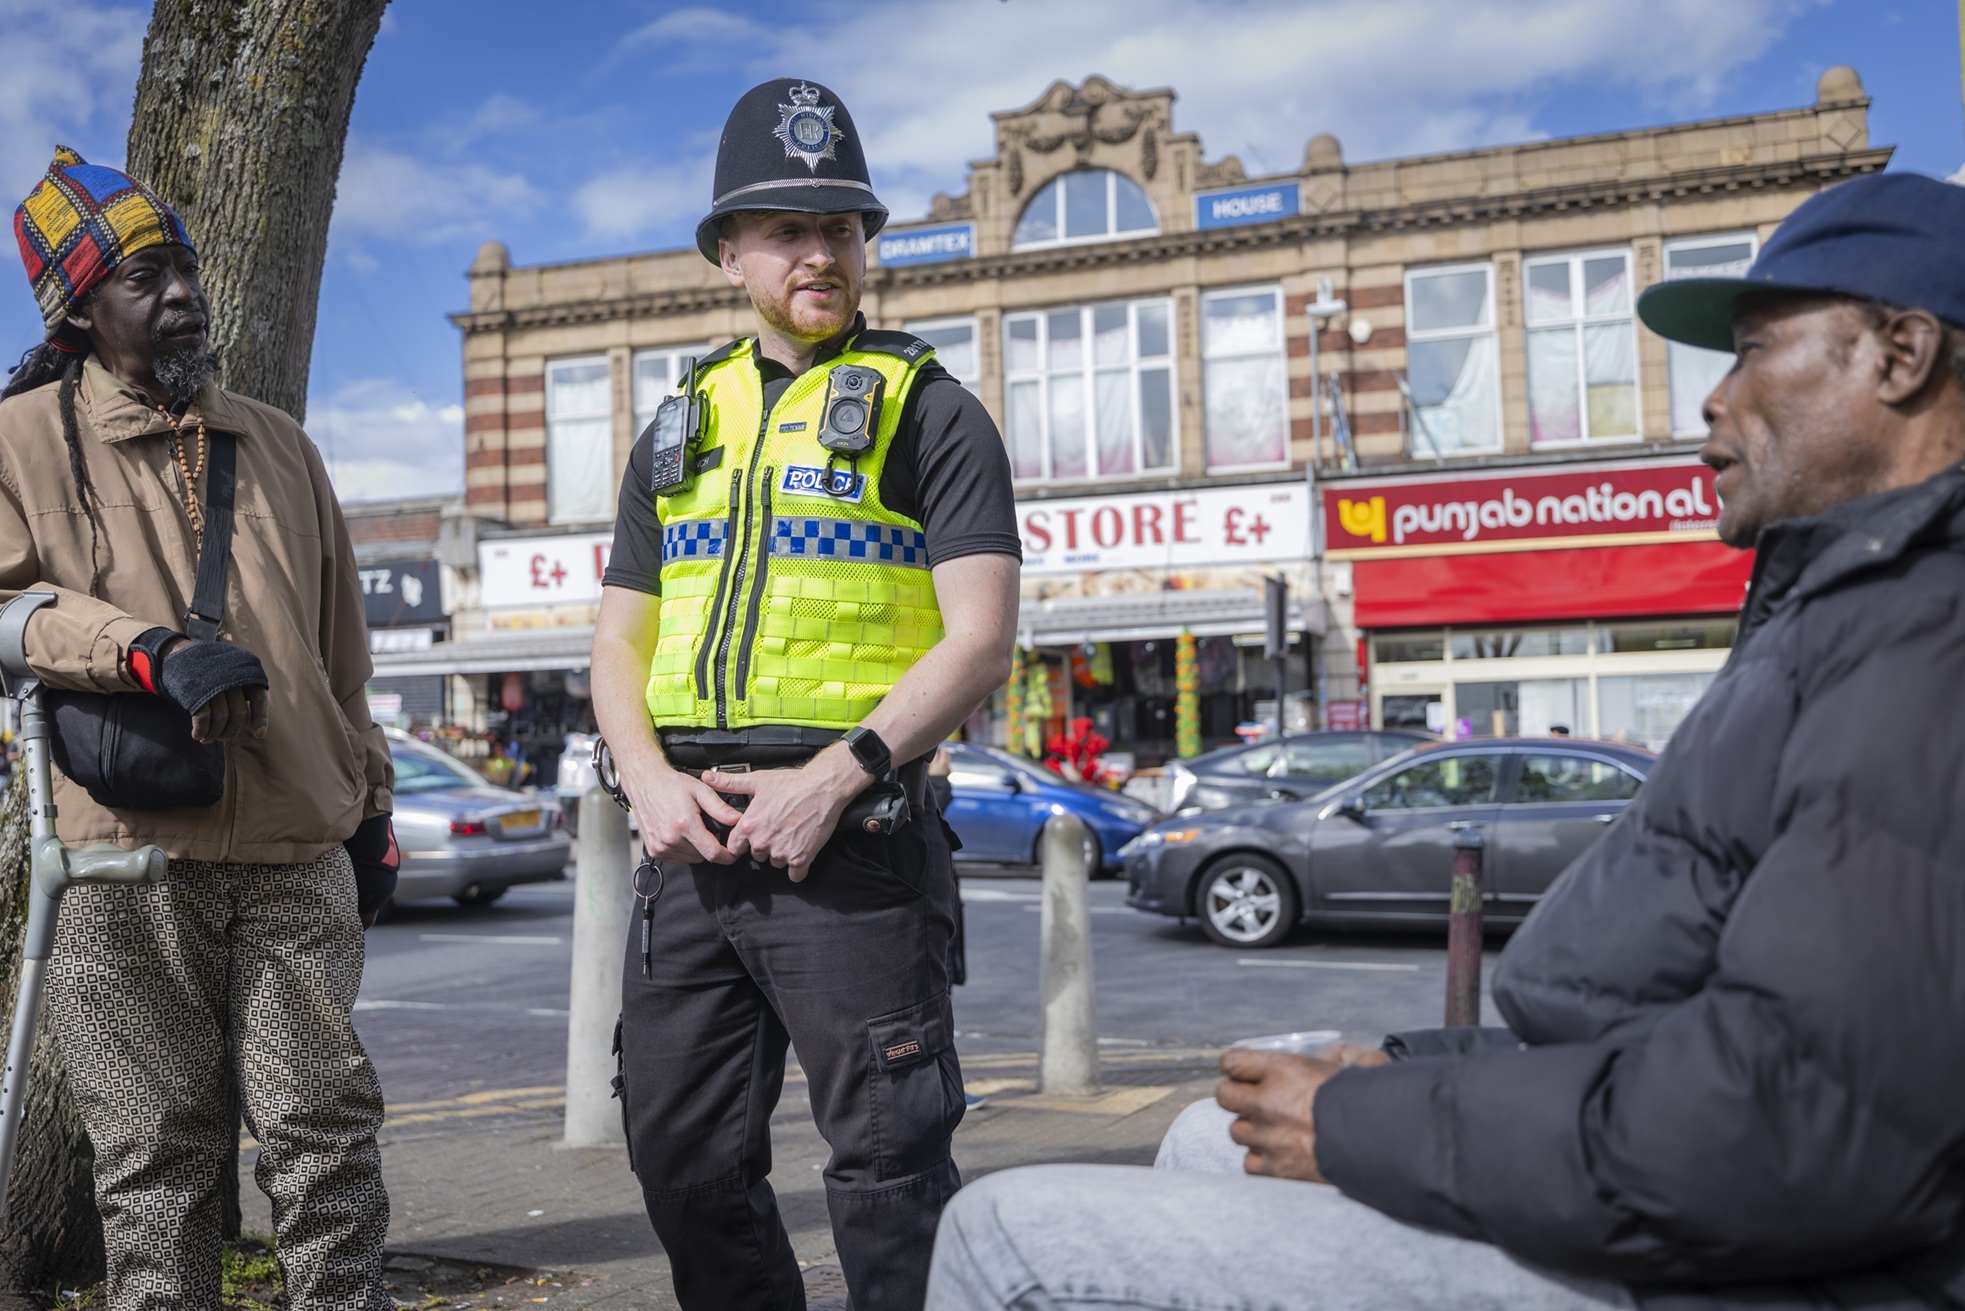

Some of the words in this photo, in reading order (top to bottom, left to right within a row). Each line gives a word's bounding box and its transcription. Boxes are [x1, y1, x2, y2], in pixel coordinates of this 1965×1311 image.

[880, 231, 969, 260] DRAMTEX
[1212, 192, 1284, 219] HOUSE
[788, 470, 857, 493] POLCE
[1393, 487, 1533, 545] punjab
[1536, 476, 1712, 525] national
[531, 555, 567, 588] £+
[1024, 498, 1201, 555] STORE
[1222, 506, 1271, 545] £+
[357, 568, 394, 595] TZ
